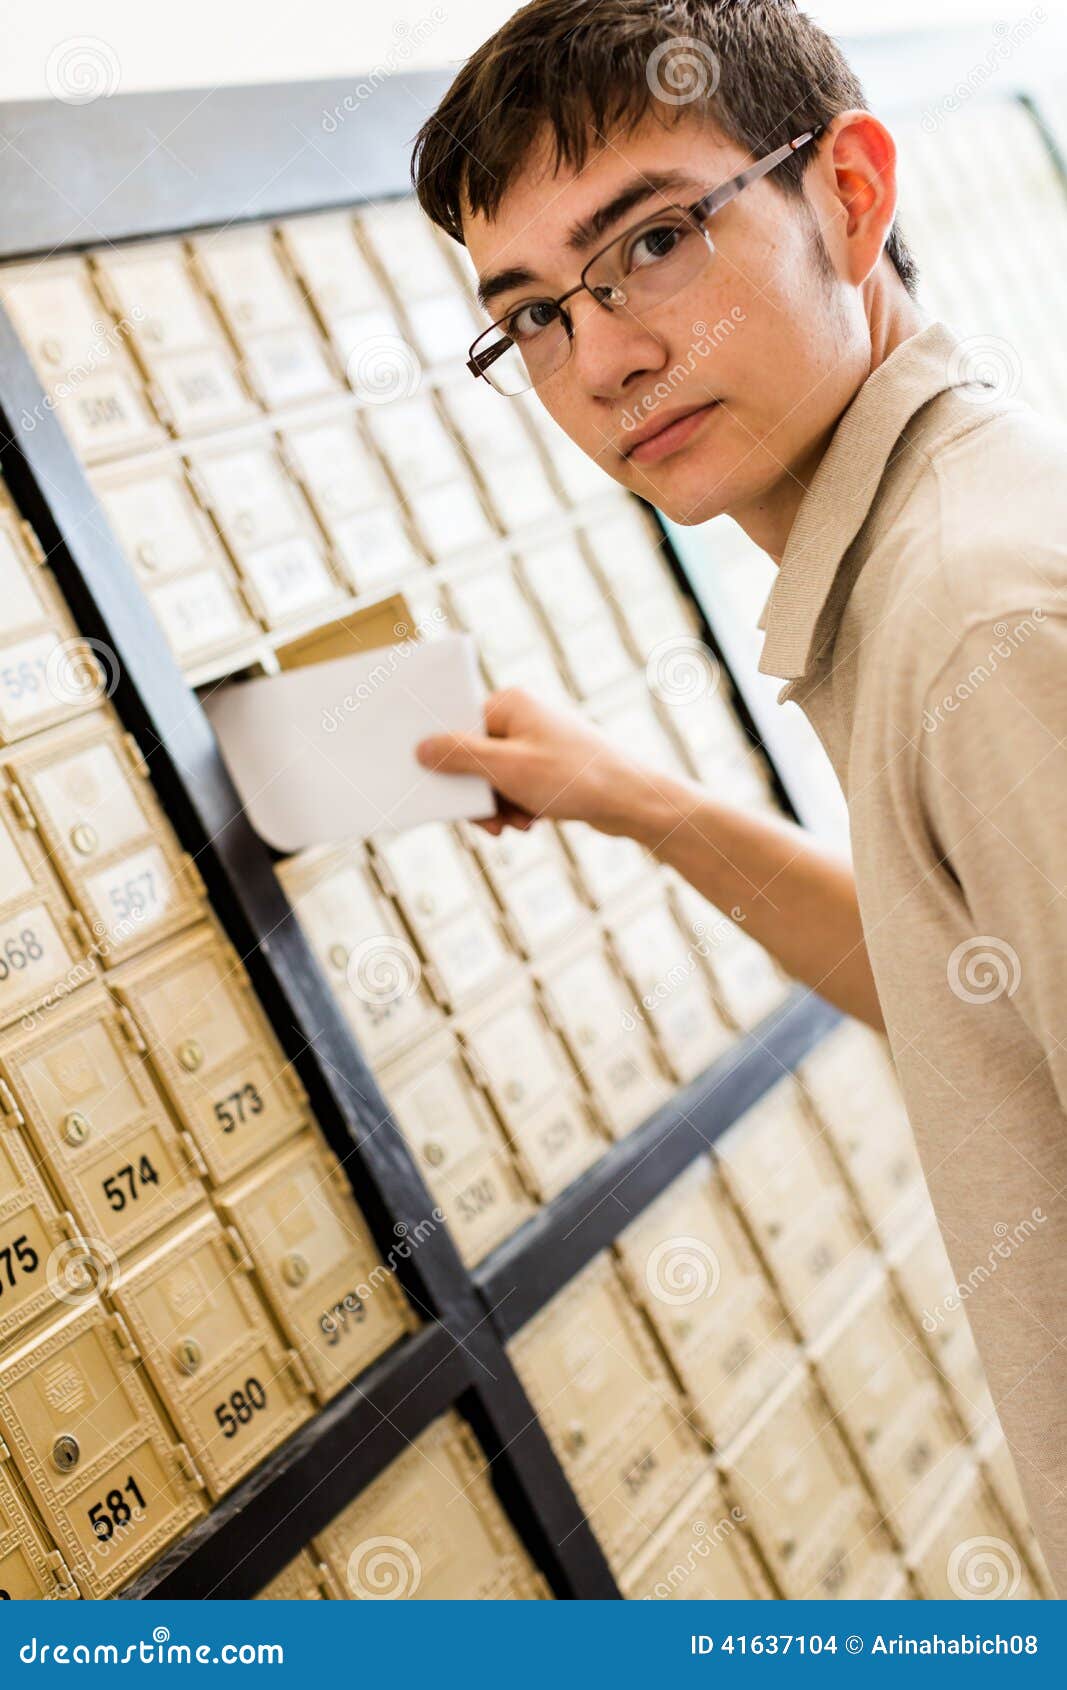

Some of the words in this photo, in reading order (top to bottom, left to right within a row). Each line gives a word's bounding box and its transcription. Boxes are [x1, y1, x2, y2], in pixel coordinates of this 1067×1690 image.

[214, 1082, 264, 1134] 573
[102, 1155, 160, 1212] 574
[0, 1234, 39, 1298] 75
[214, 1376, 267, 1439] 580
[87, 1475, 147, 1542] 581
